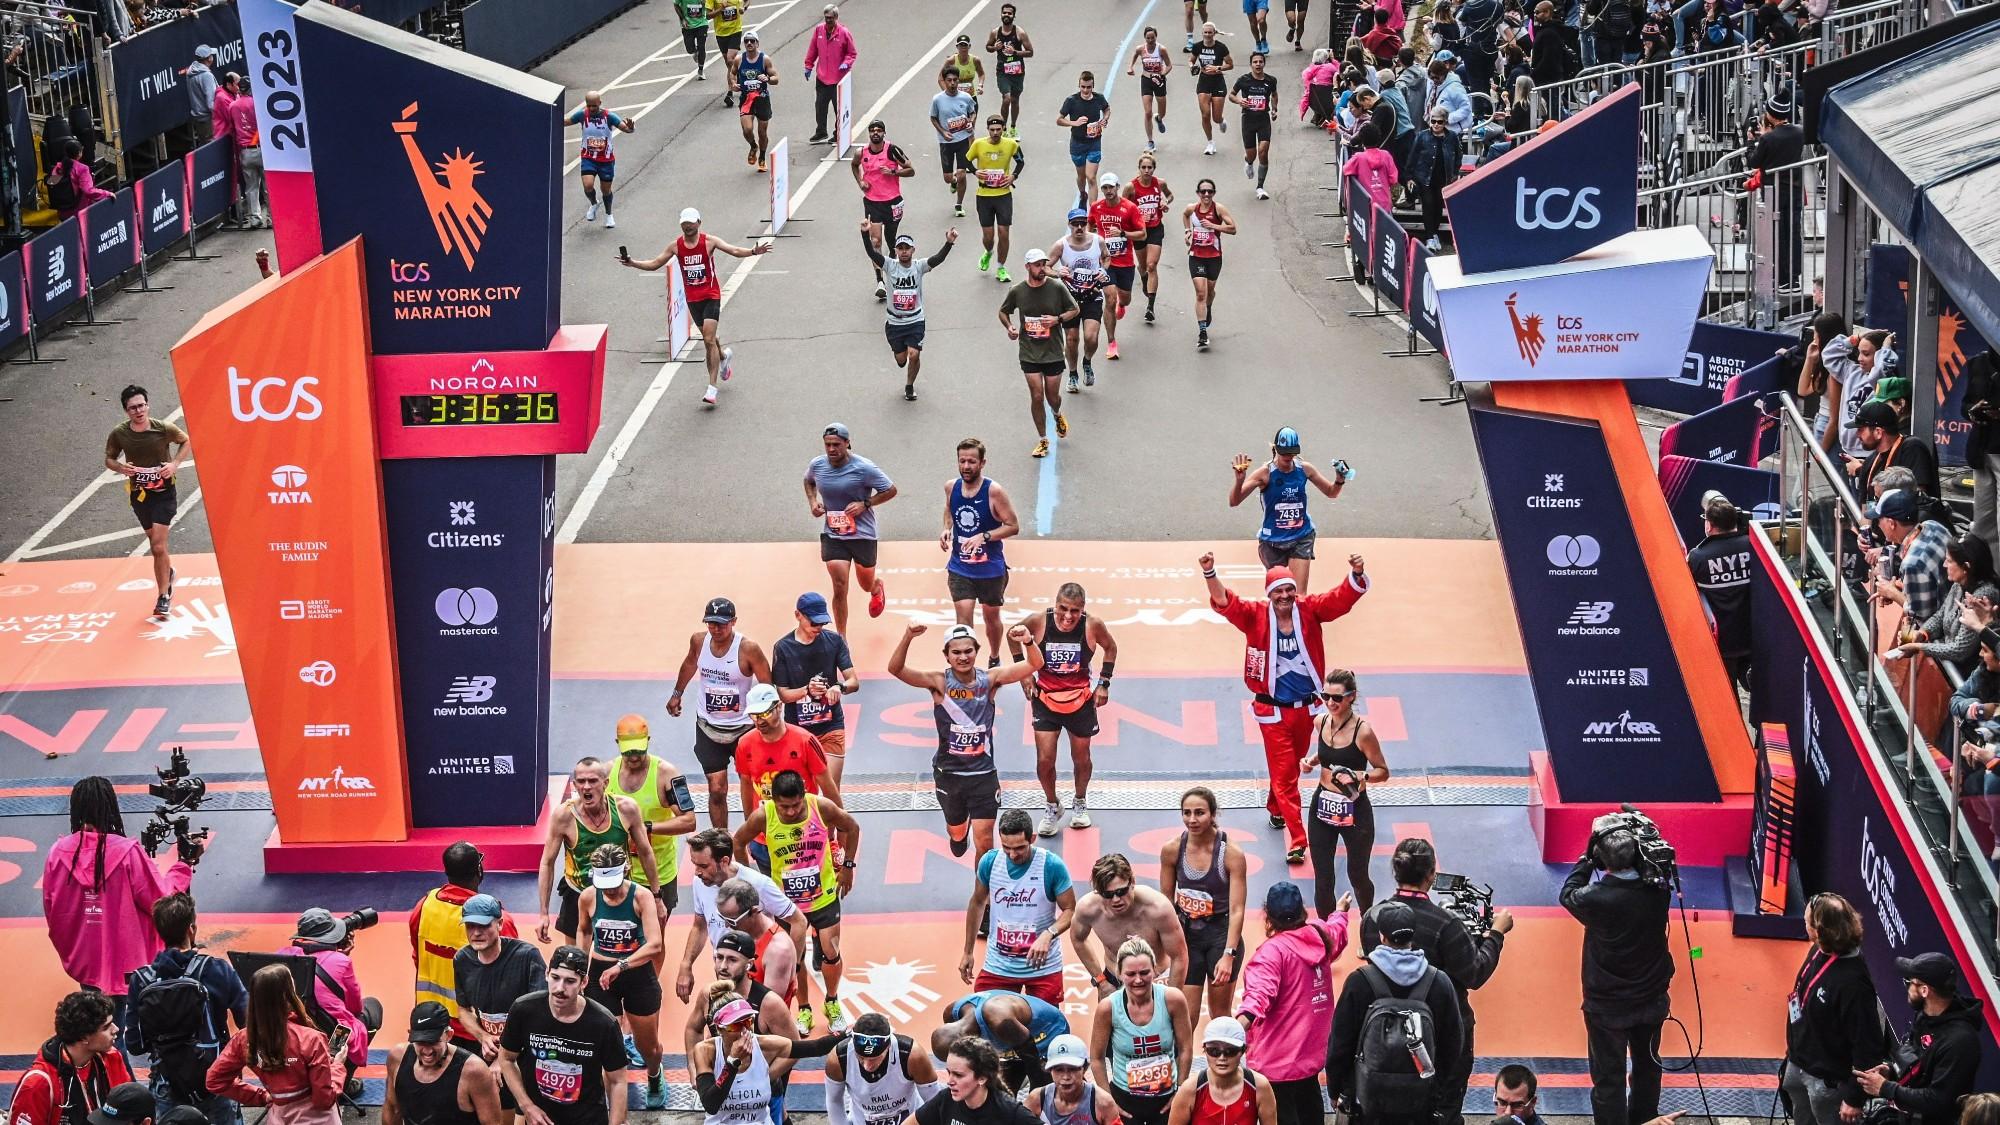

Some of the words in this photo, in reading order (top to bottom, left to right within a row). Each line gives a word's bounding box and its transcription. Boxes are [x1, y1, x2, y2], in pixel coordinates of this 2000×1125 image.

[139, 77, 151, 101] IT
[153, 66, 177, 95] WILL
[214, 39, 243, 67] MOVE
[258, 29, 306, 151] 2023
[1137, 194, 1161, 205] NYAC
[1515, 176, 1601, 230] tcs
[1099, 214, 1122, 223] JUSTIN
[100, 226, 118, 241] UNITED
[1109, 241, 1124, 251] 7437
[390, 258, 431, 283] tcs
[1076, 273, 1093, 282] 8014
[45, 289, 55, 302] new
[54, 278, 73, 299] balance
[393, 288, 433, 303] NEW
[436, 287, 482, 302] YORK
[484, 286, 521, 300] CITY
[896, 295, 914, 303] 6975
[394, 304, 492, 320] MARATHON
[1557, 314, 1583, 330] tcs
[1557, 334, 1582, 343] NEW
[1585, 333, 1614, 342] YORK
[1616, 333, 1640, 342] CITY
[1557, 344, 1619, 353] MARATHON
[1708, 355, 1746, 368] ABBOTT
[1708, 363, 1742, 376] WORLD
[430, 375, 537, 391] NORQAIN
[228, 366, 323, 422] tcs
[136, 472, 162, 482] 22790
[267, 491, 313, 504] TATA
[1526, 495, 1581, 508] Citizens
[1279, 508, 1300, 519] 7433
[269, 542, 291, 551] THE
[293, 541, 328, 551] RUDIN
[427, 531, 502, 548] Citizens
[282, 553, 320, 562] FAMILY
[1010, 566, 1106, 574] MARATH
[1548, 568, 1598, 576] mastercard
[1710, 569, 1751, 584] POLI
[439, 626, 499, 636] mastercard
[1557, 626, 1577, 635] new
[1579, 626, 1620, 635] balance
[1050, 650, 1076, 662] 9537
[709, 694, 734, 705] 7567
[433, 706, 458, 717] new
[459, 705, 507, 716] balance
[303, 724, 351, 737] ESPN
[955, 732, 980, 744] 7875
[439, 757, 490, 767] UNITED
[428, 765, 491, 775] AIRLINES
[1321, 799, 1348, 814] 11681
[800, 854, 817, 863] YORK
[1860, 815, 1881, 905] tcs
[788, 875, 816, 890] 5678
[994, 887, 1036, 909] Capital
[1179, 895, 1207, 912] 6299
[1880, 878, 1909, 946] CONSULTANCY
[1877, 902, 1896, 949] SERVICES
[601, 929, 632, 941] 7454
[1000, 929, 1031, 944] 11347
[529, 1040, 544, 1049] NYC
[545, 1043, 575, 1055] Marathon
[576, 1049, 593, 1057] 2023
[541, 1071, 575, 1088] 4979
[1131, 1065, 1169, 1083] 12936
[861, 1096, 907, 1112] BARCELONA
[871, 1093, 892, 1104] RAUL
[730, 1112, 757, 1121] SPAIN
